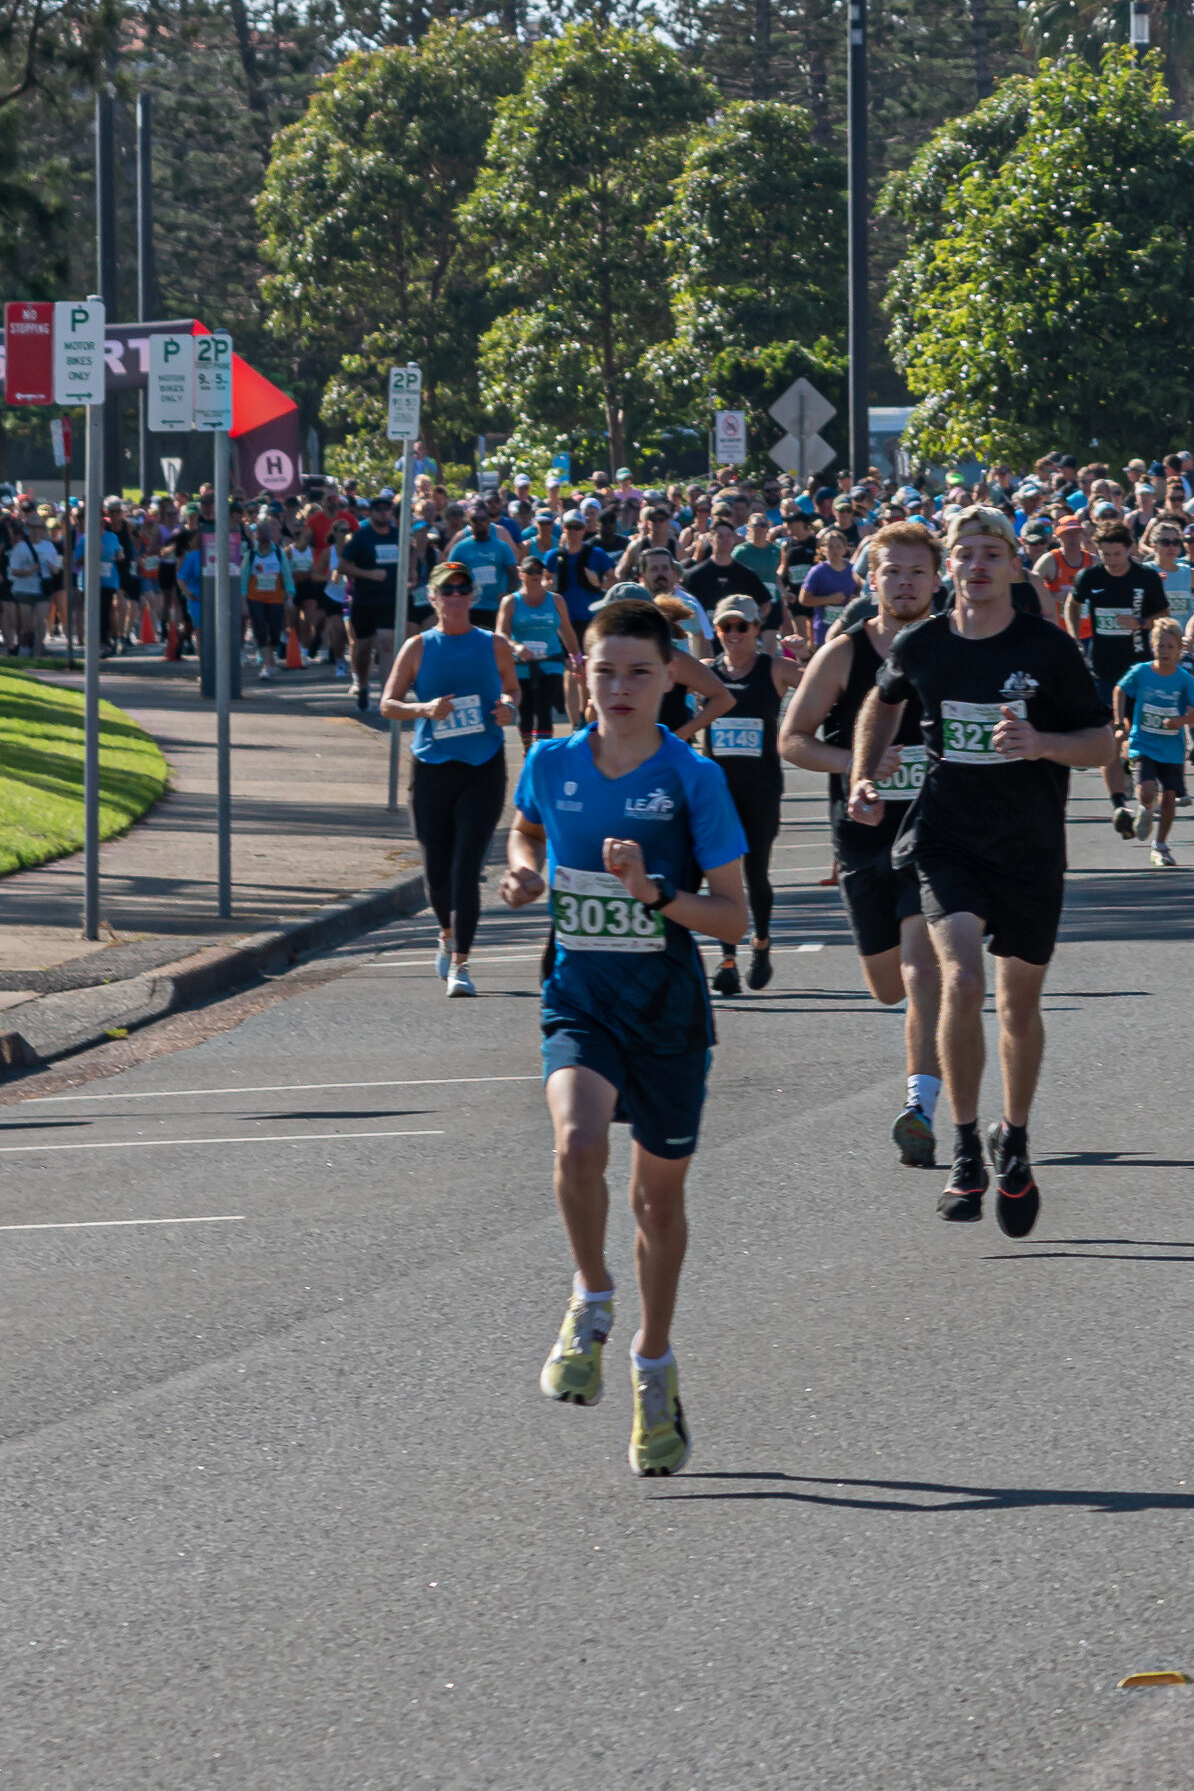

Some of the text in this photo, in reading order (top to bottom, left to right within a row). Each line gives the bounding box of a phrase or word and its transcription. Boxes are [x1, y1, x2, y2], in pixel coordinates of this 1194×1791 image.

[22, 309, 38, 321] NO
[71, 309, 89, 333] P
[9, 322, 50, 335] STOPPING
[64, 341, 95, 351] MOTOR
[163, 339, 180, 363] P
[198, 338, 229, 362] 2P
[66, 356, 92, 366] BIKES
[68, 371, 90, 381] ONLY
[393, 372, 418, 389] 2P
[266, 456, 283, 475] H
[715, 730, 760, 747] 2149
[558, 896, 658, 936] 3038
